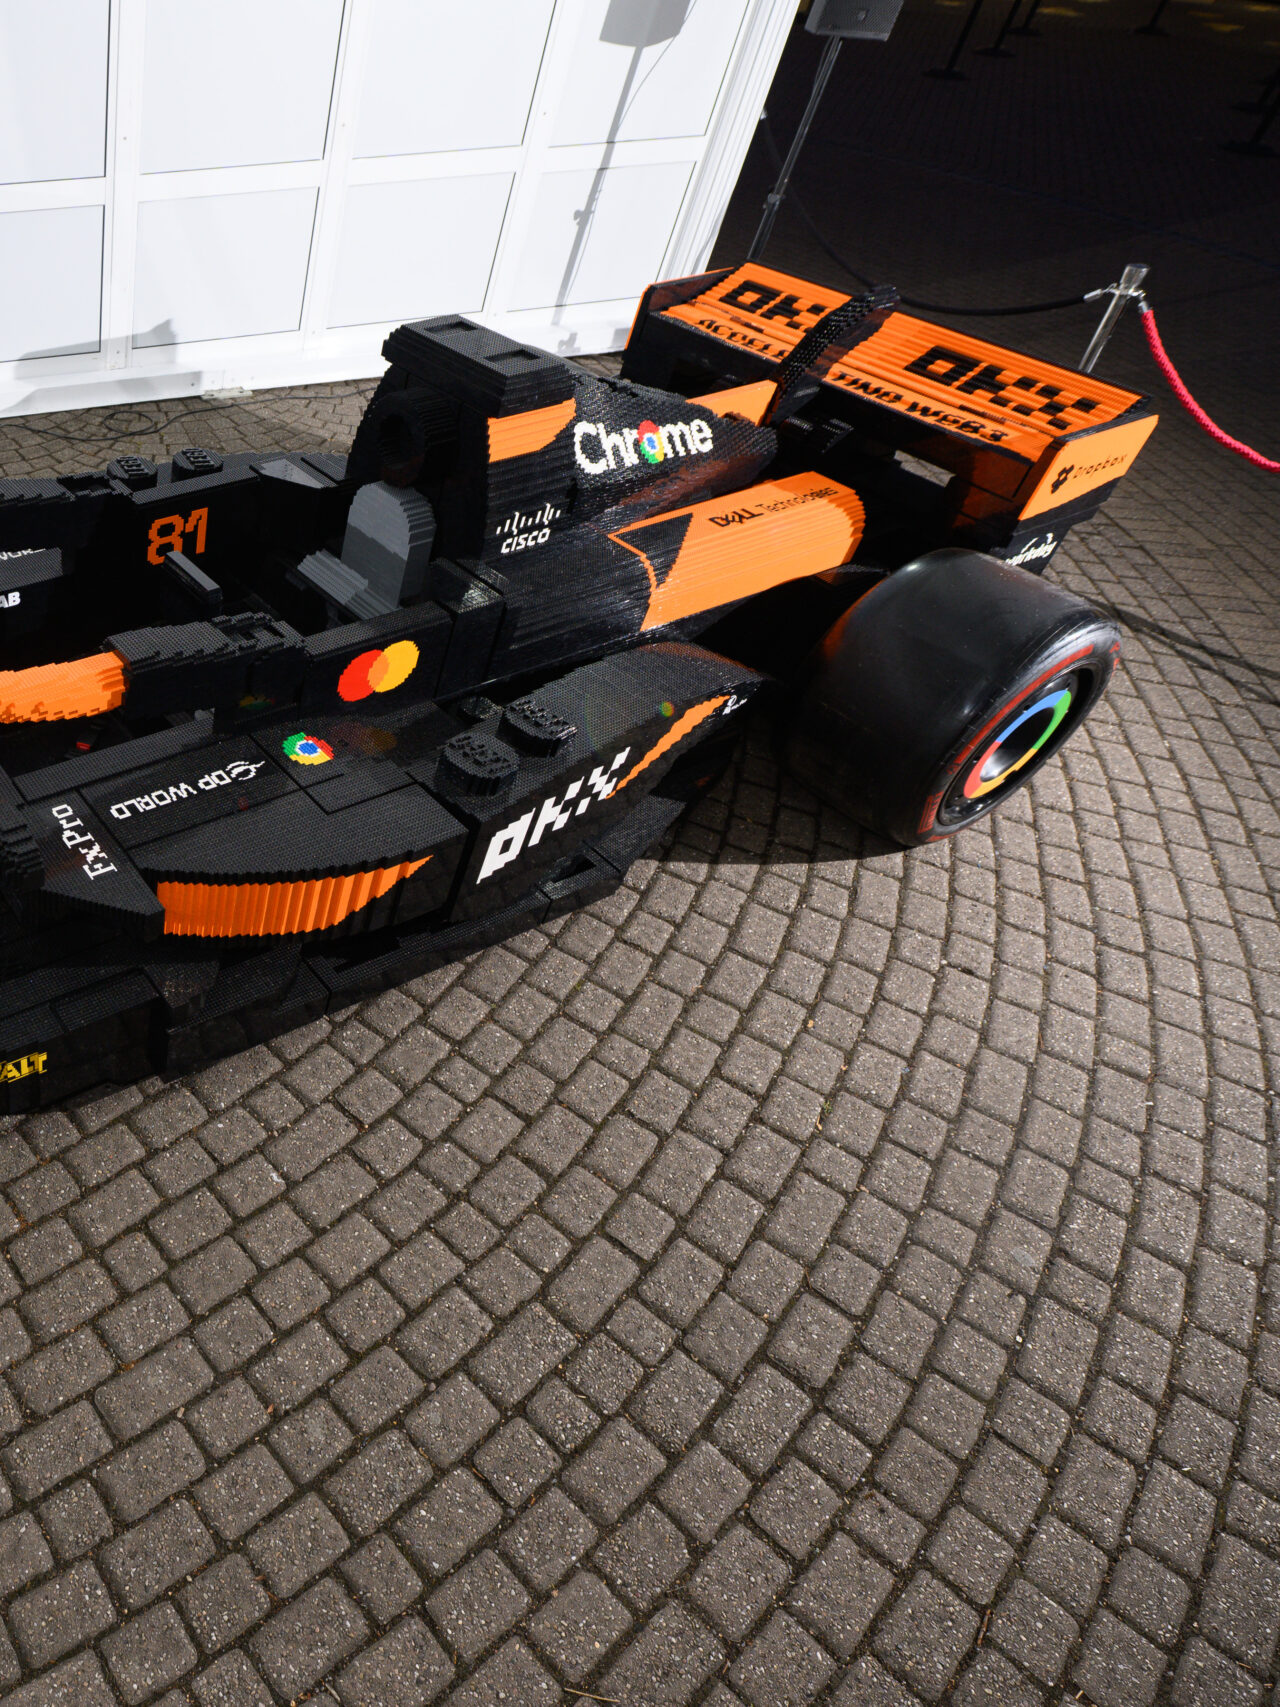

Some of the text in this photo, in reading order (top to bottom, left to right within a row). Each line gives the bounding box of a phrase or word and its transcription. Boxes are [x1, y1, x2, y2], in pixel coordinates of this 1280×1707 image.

[904, 345, 1101, 432] OKX
[573, 418, 714, 475] Chrome
[1072, 454, 1128, 481] Dropbox
[147, 507, 208, 566] 81
[109, 769, 233, 820] DP WORLD
[476, 746, 631, 885] OKX
[51, 803, 118, 881] FxPro
